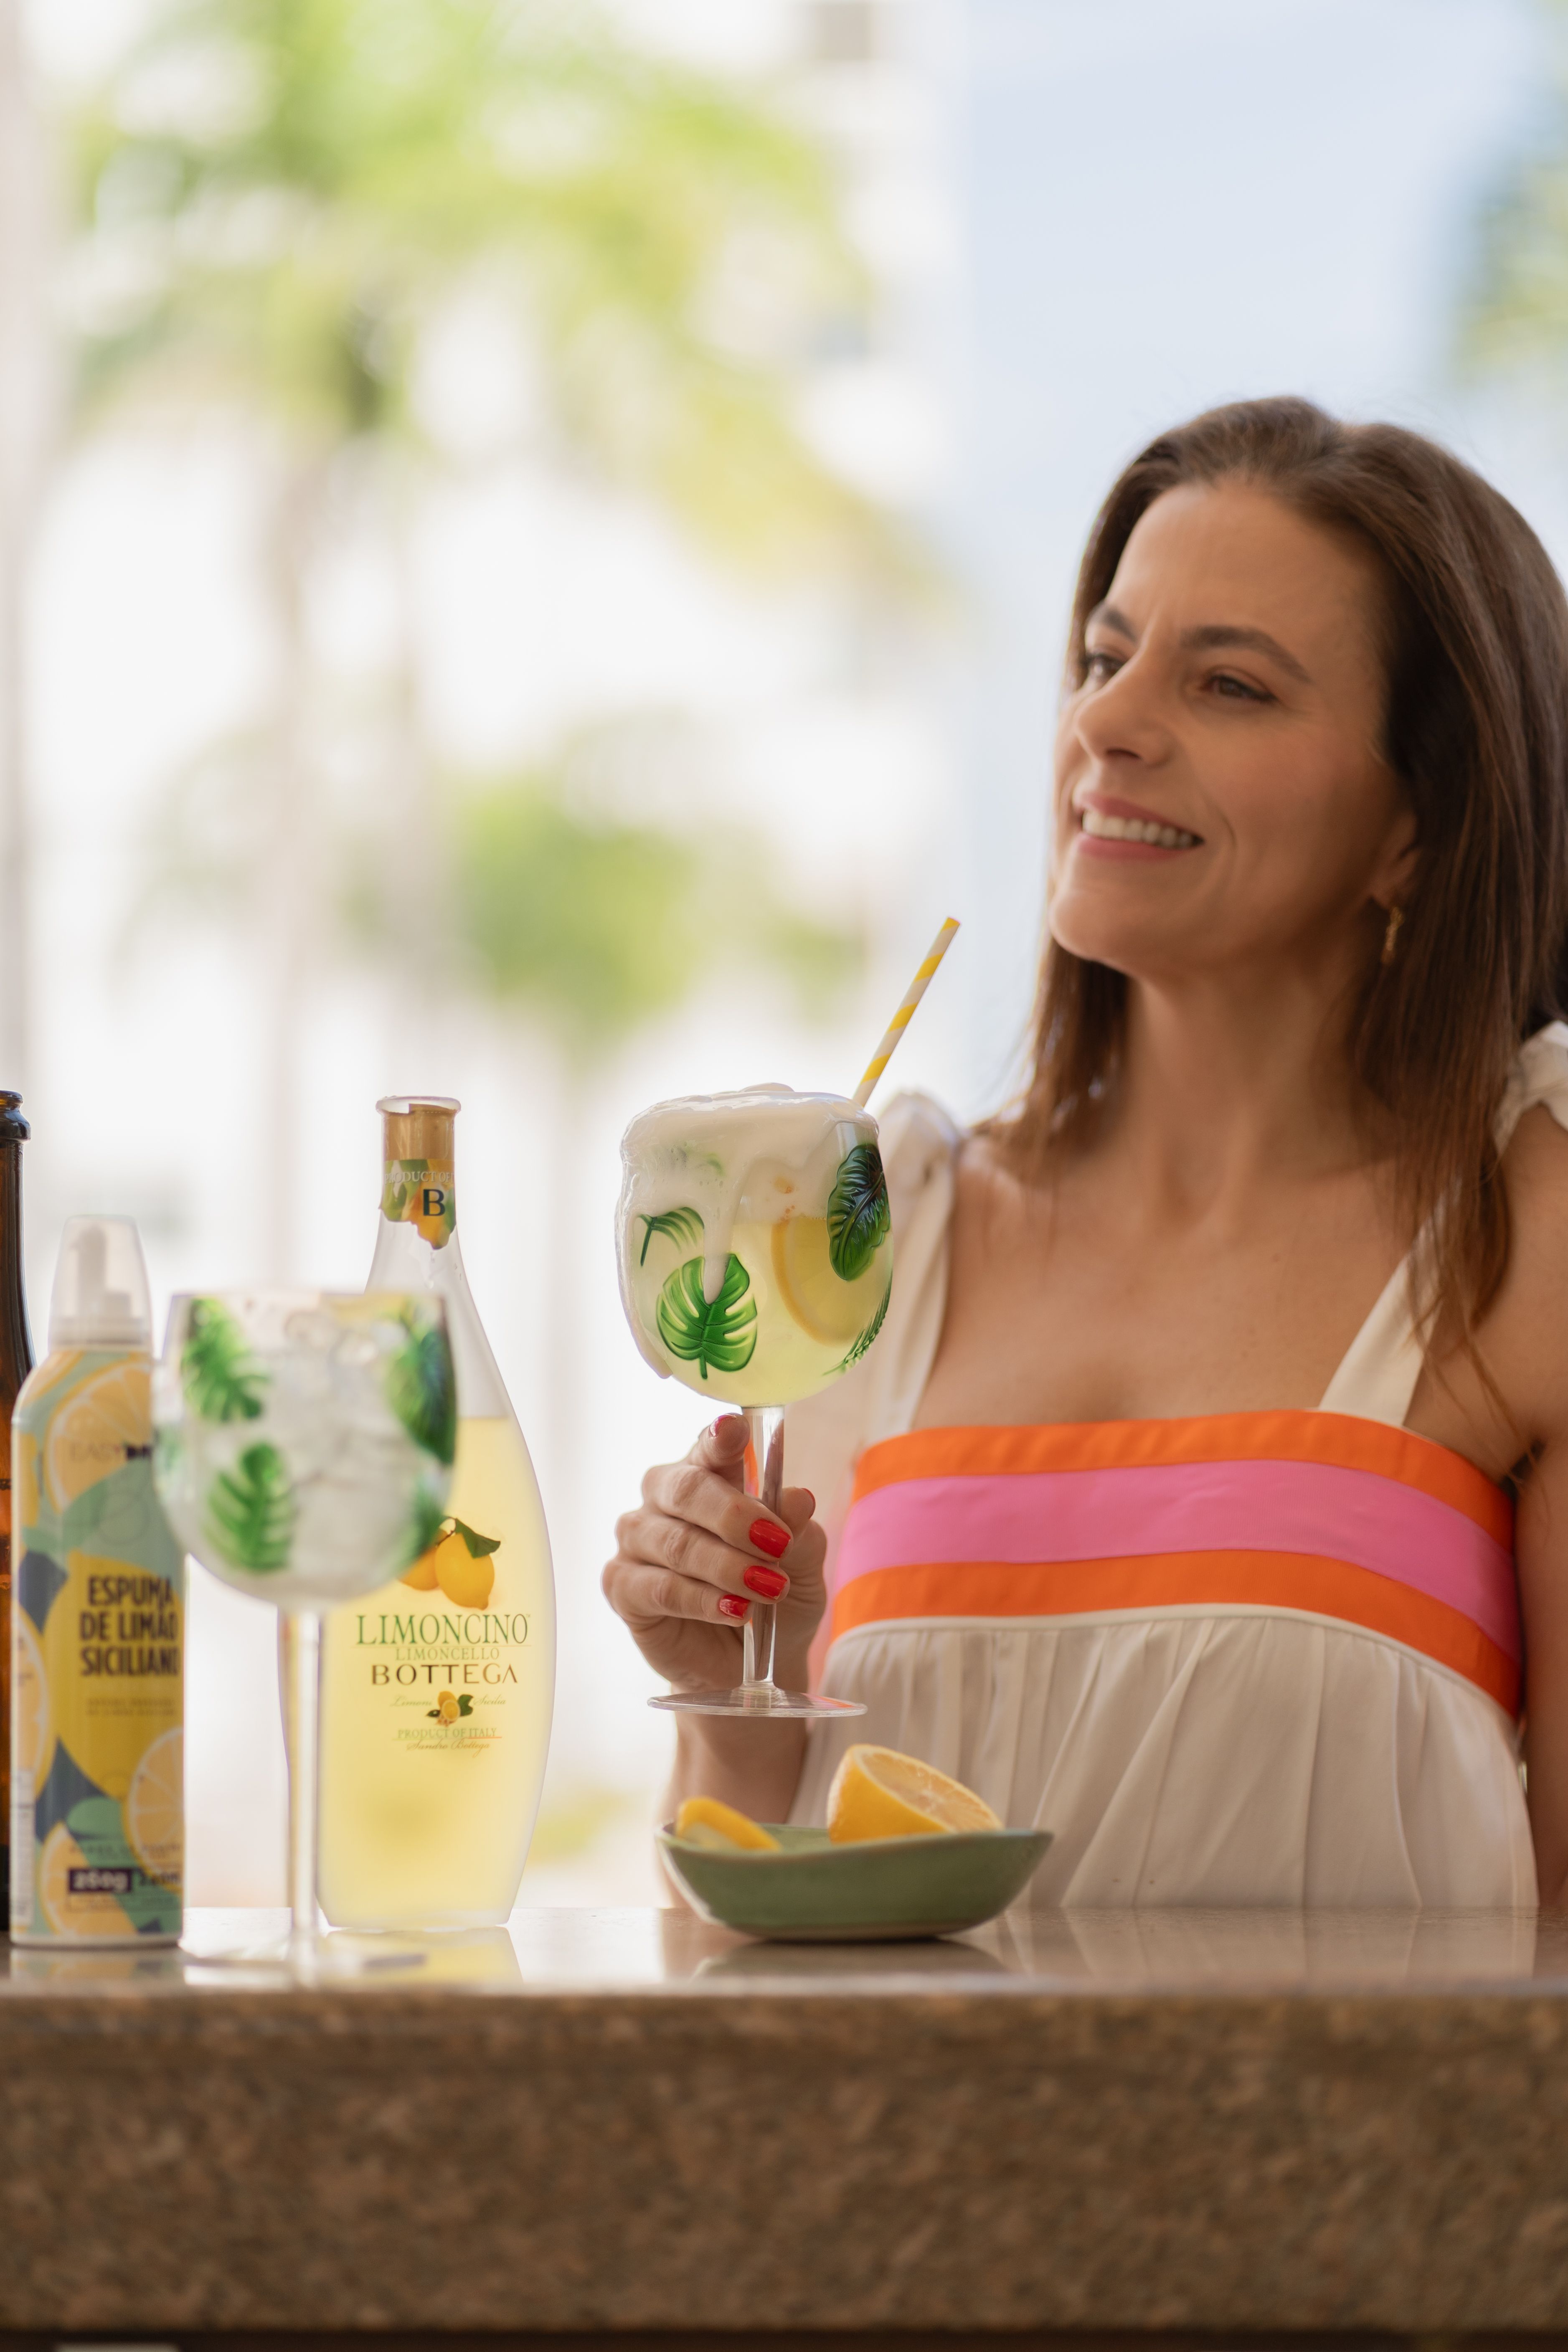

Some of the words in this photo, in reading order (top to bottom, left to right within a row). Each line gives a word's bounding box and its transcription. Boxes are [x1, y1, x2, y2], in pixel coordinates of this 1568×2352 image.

[385, 1171, 436, 1184] PRODUCT
[439, 1171, 450, 1183] OF
[423, 1189, 446, 1216] B
[89, 1576, 173, 1605] ESPUMA
[81, 1613, 109, 1640] DE
[356, 1614, 527, 1644] LIMONCINO
[395, 1647, 500, 1661] LIMONCELLO
[372, 1663, 518, 1685] BOTTEGA
[473, 1694, 506, 1706] Sicilia
[398, 1729, 449, 1738] PRODUCT
[452, 1728, 467, 1738] OF
[468, 1728, 497, 1737] ITALY
[406, 1738, 449, 1751] Sandro
[451, 1738, 491, 1758] Bottega
